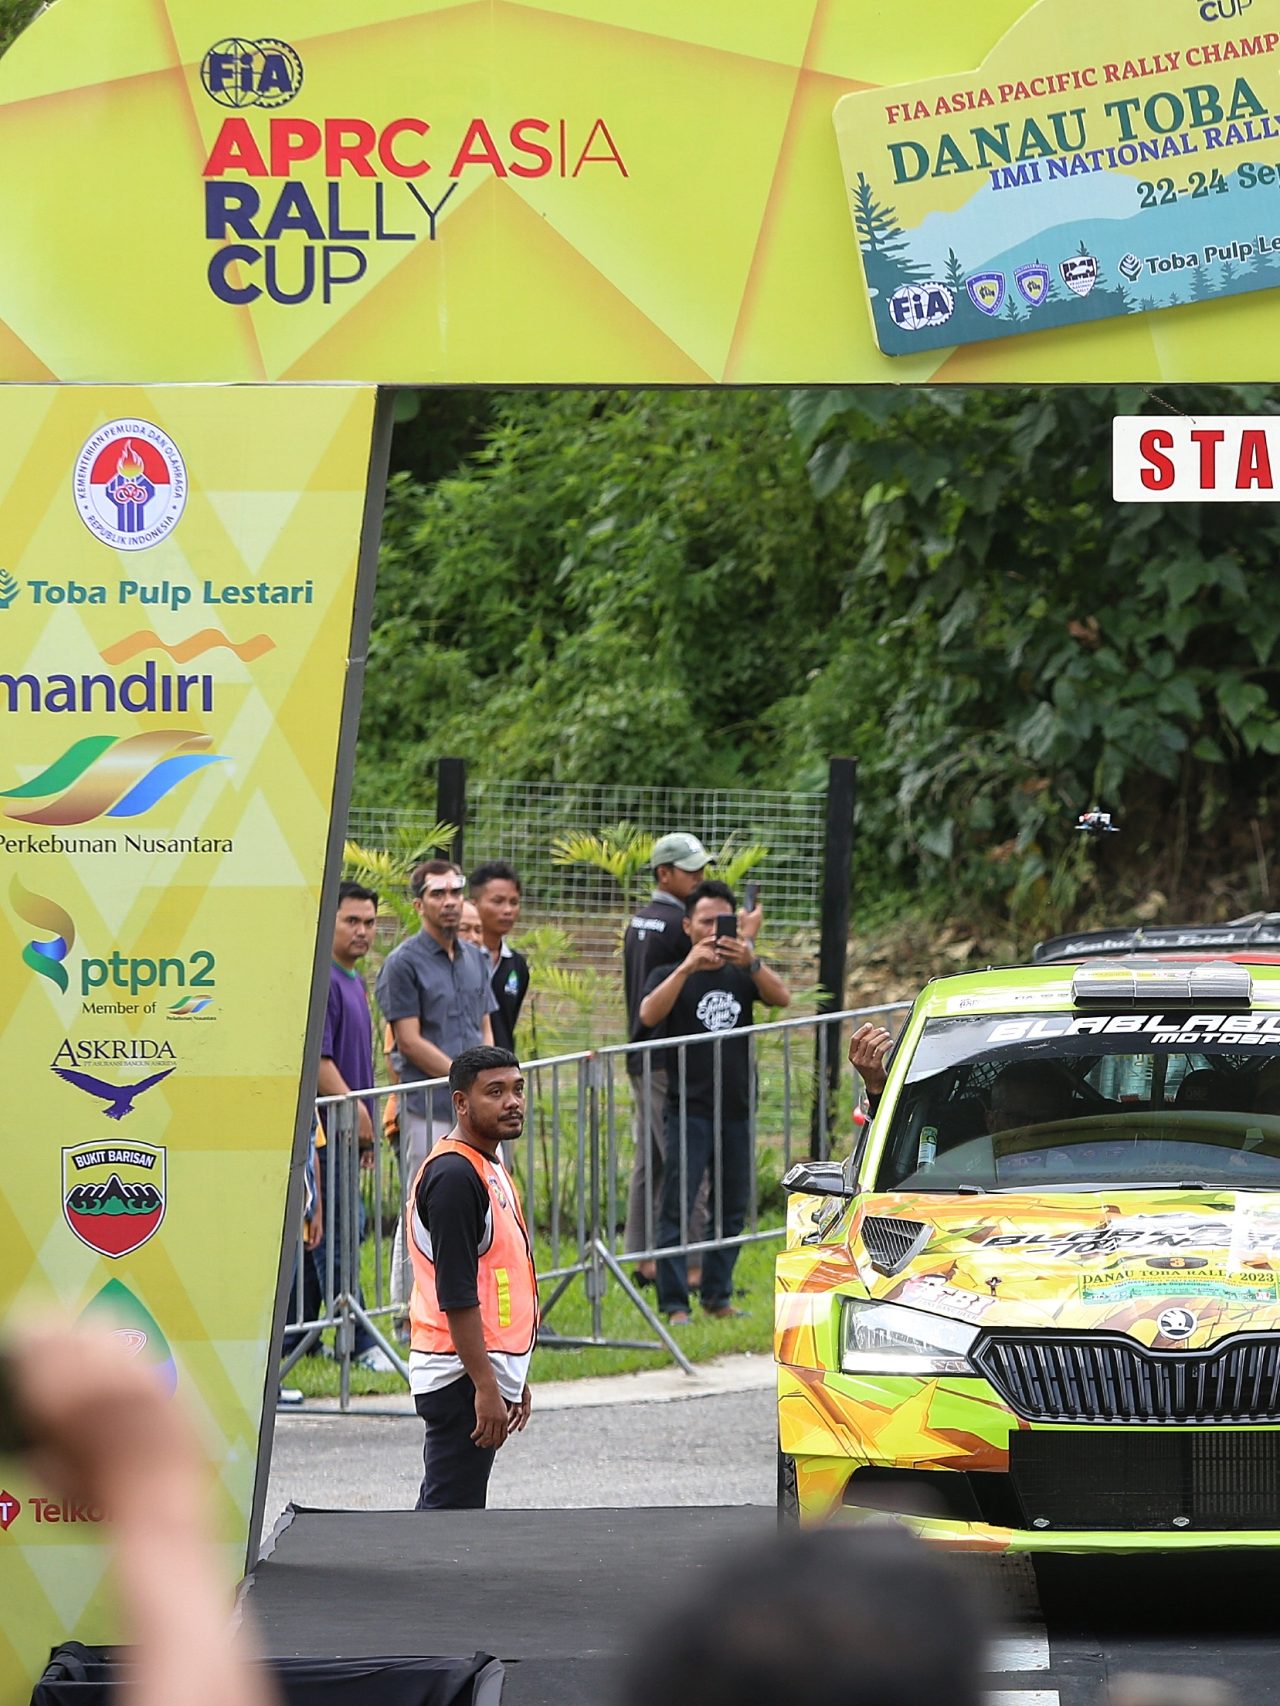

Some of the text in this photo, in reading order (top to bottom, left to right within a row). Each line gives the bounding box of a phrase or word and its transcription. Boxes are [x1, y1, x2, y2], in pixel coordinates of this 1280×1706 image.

[885, 98, 932, 125] FIA
[934, 87, 996, 116] ASIA
[998, 67, 1098, 104] PACIFIC
[1103, 51, 1181, 84] RALLY
[202, 117, 629, 178] APRC ASIA
[886, 107, 1088, 185] DANAU
[1104, 76, 1268, 143] TOBA
[990, 158, 1042, 191] IMI
[1046, 132, 1198, 182] NATIONAL
[1136, 167, 1229, 209] 22-24
[204, 181, 459, 241] RALLY
[206, 244, 368, 305] CUP
[1146, 252, 1199, 276] Toba
[1203, 241, 1253, 264] Pulp
[76, 423, 184, 500] KEMENTERIAN PEMUDA DAN OLAHRAGA
[86, 514, 175, 546] REPUBLIK INDONESIA
[27, 580, 314, 611] Toba Pulp Lestari
[124, 833, 234, 854] Nusantara
[81, 950, 216, 996] ptpn2
[82, 1001, 158, 1014] Member of
[50, 1038, 178, 1067] ASKRIDA
[76, 1151, 155, 1168] BUKIT BARISAN
[1082, 1270, 1134, 1284] DANAU
[1240, 1272, 1274, 1282] 2023
[1169, 1257, 1186, 1268] 3
